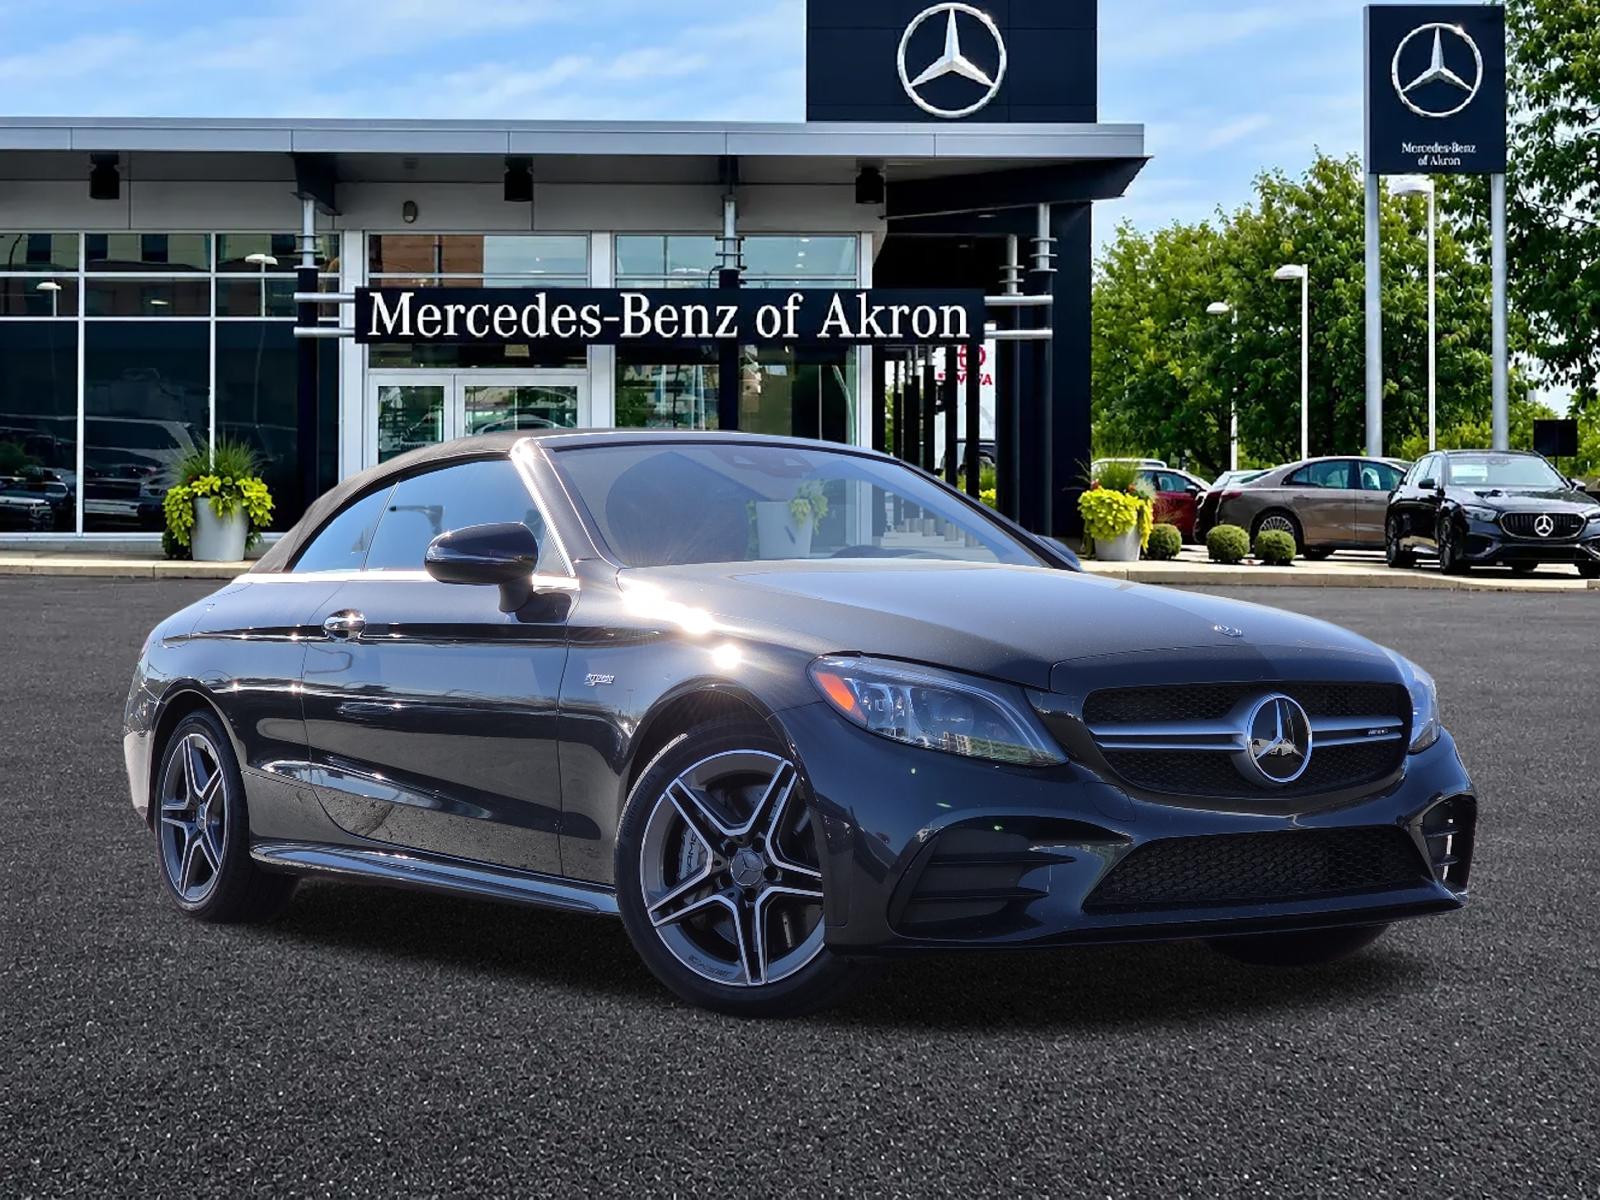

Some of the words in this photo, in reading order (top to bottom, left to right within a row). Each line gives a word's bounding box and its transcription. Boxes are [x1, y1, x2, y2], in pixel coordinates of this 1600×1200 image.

[1401, 141, 1477, 154] Mercedes-Benz
[1417, 154, 1429, 166] of
[1430, 154, 1461, 166] Akron
[367, 291, 739, 339] Mercedes-Benz
[755, 292, 804, 339] of
[816, 291, 971, 339] Akron
